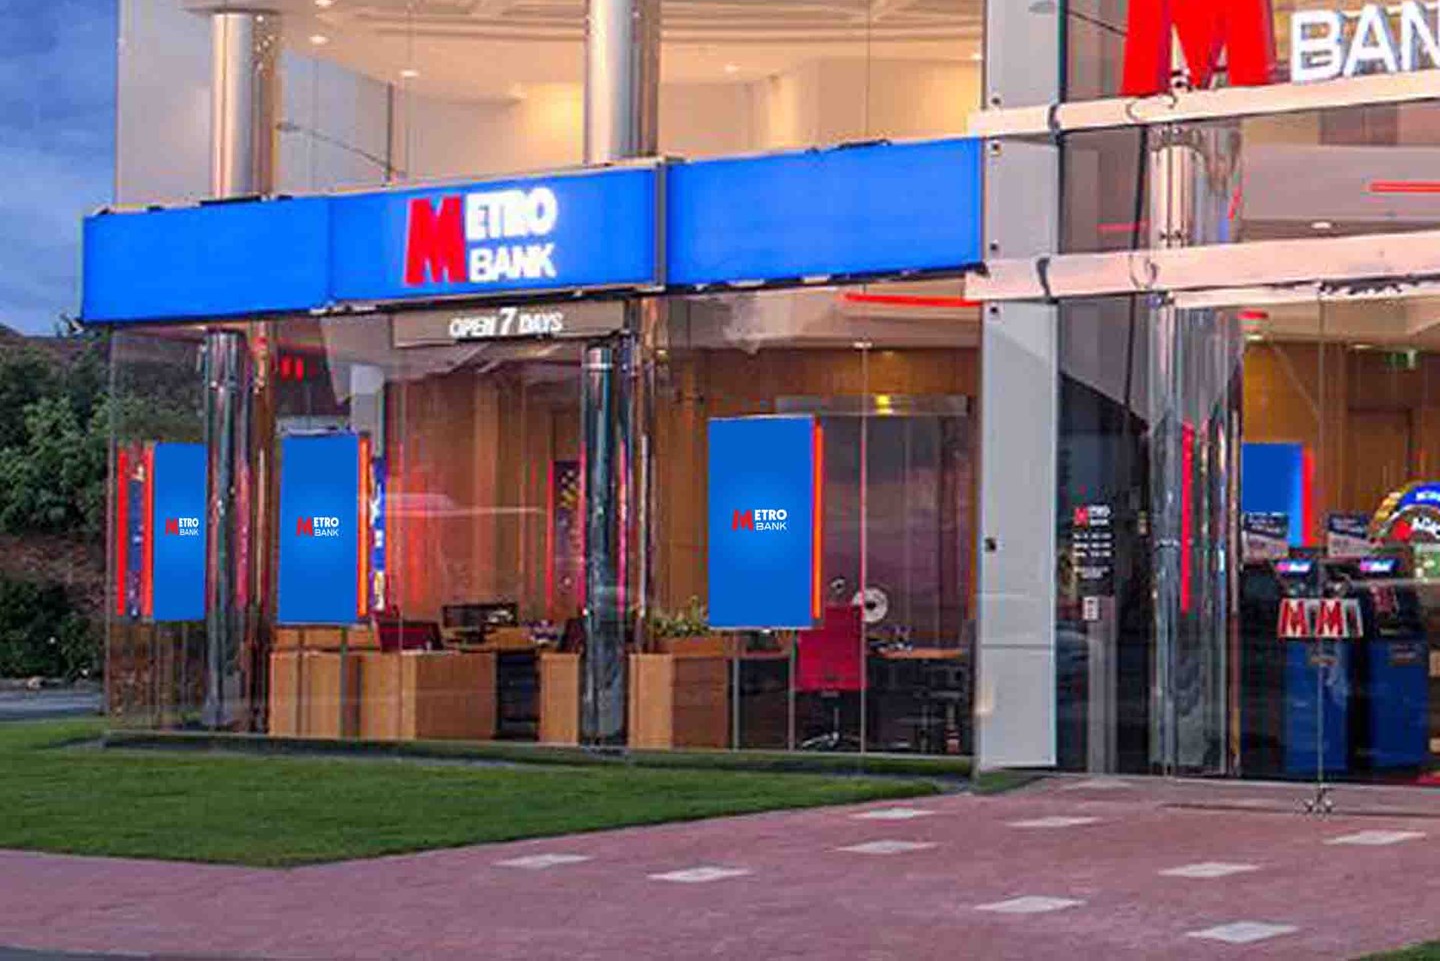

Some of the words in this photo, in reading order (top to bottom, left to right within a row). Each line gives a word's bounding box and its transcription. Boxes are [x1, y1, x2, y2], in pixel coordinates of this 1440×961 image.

[406, 188, 557, 284] METRO
[470, 244, 557, 282] BANK
[500, 307, 517, 336] 7
[519, 312, 563, 334] DAYS
[165, 518, 199, 536] METRO
[296, 516, 339, 536] METRO
[732, 509, 787, 531] METRO
[755, 522, 787, 530] BANK
